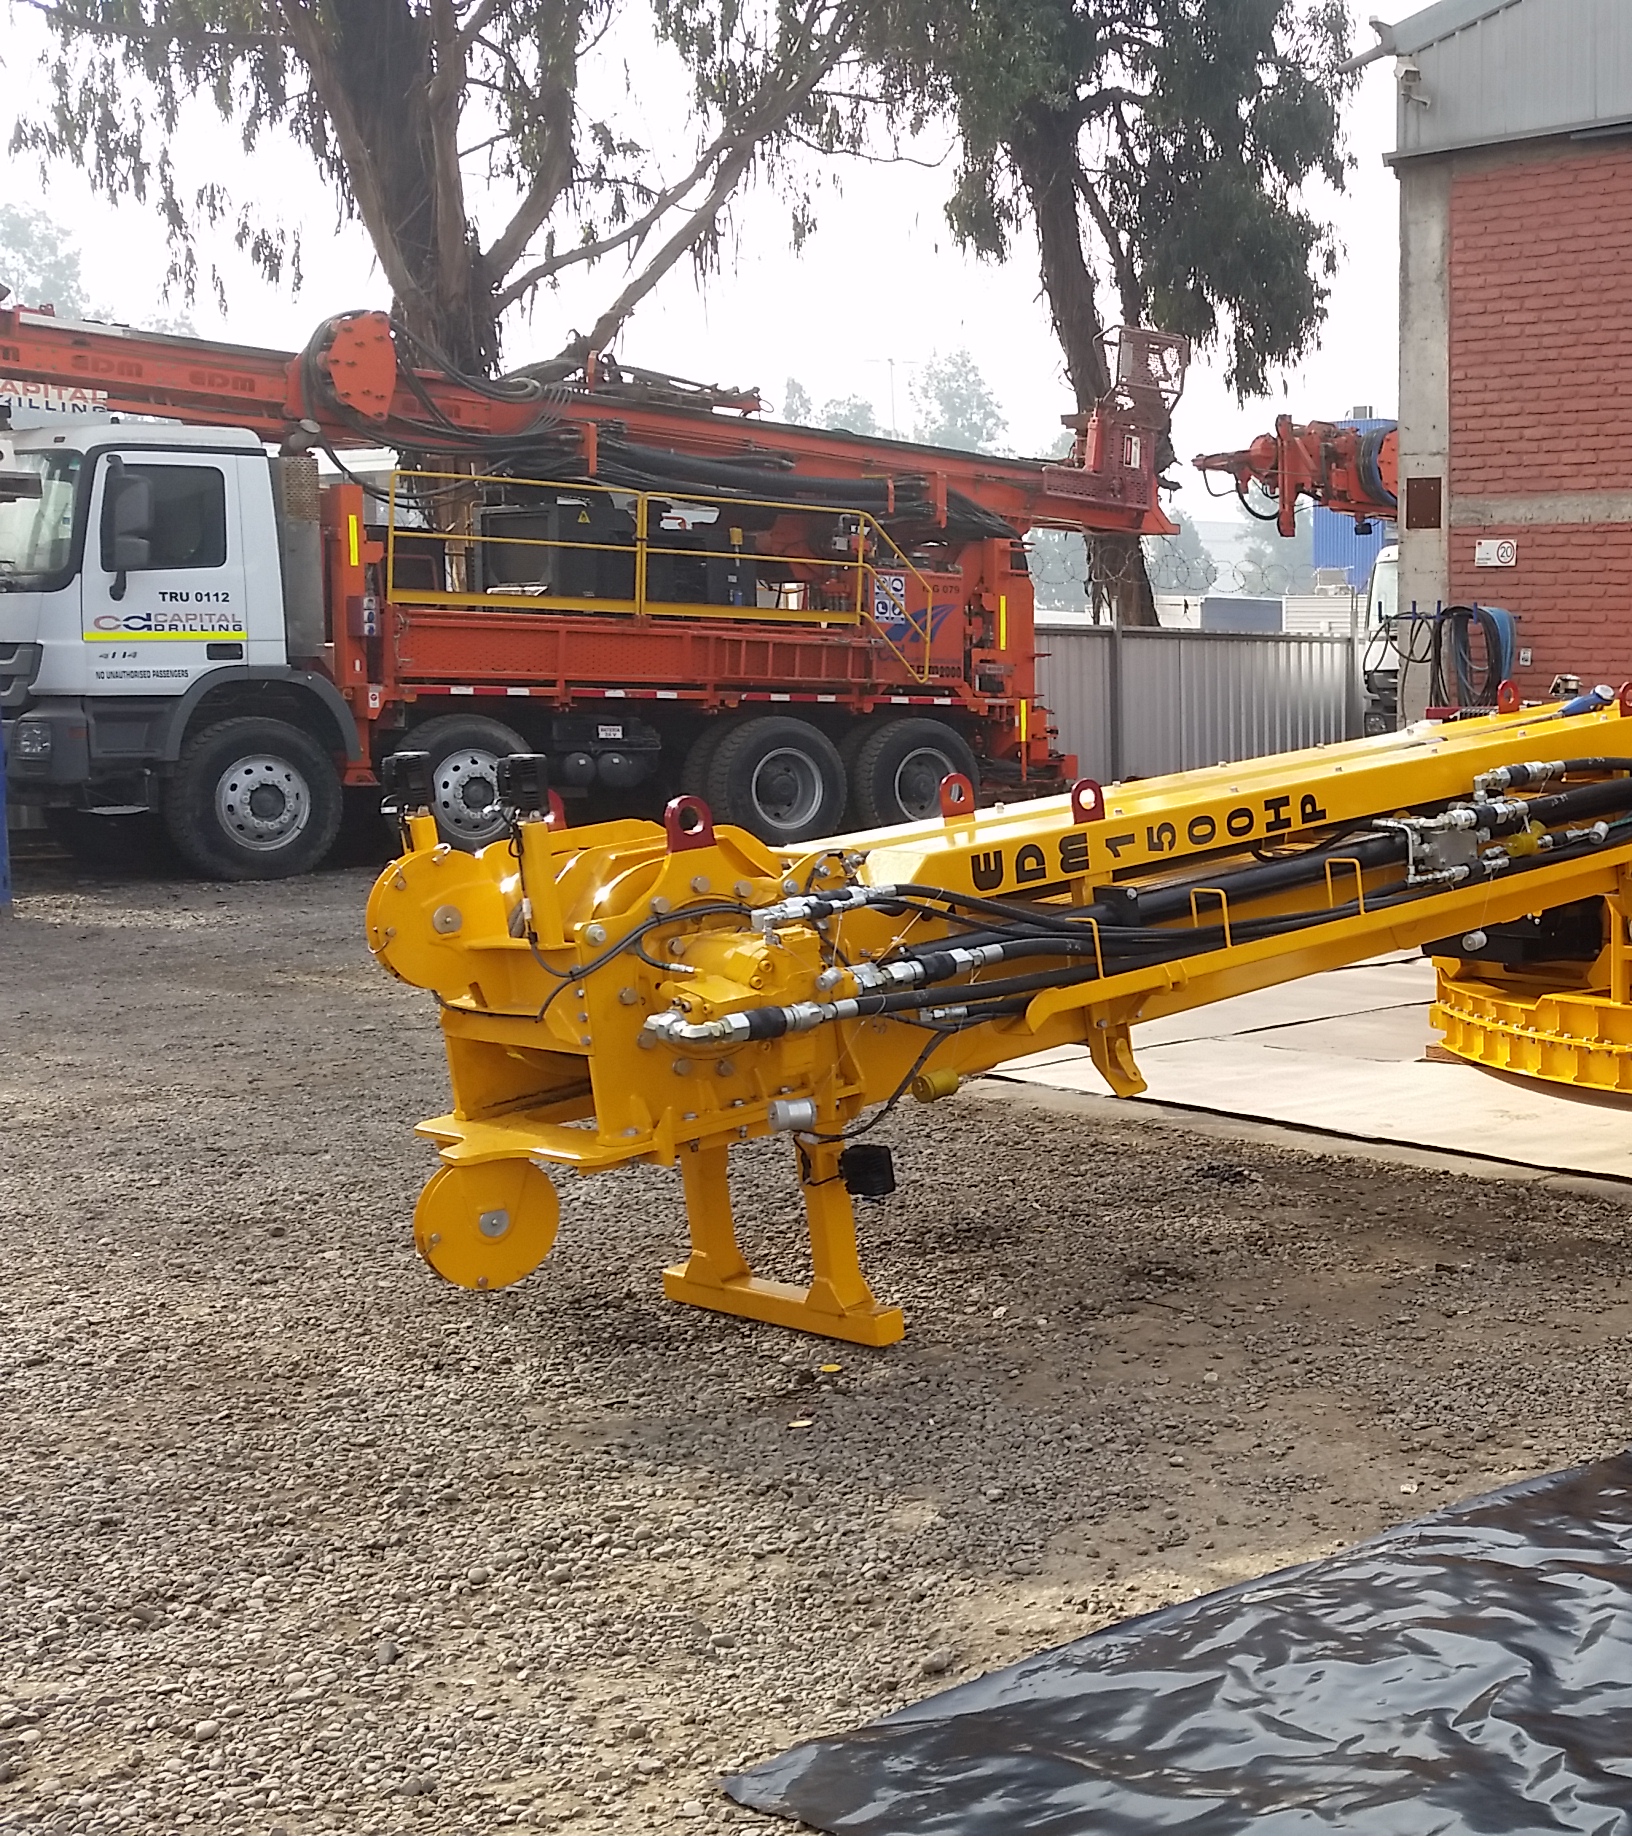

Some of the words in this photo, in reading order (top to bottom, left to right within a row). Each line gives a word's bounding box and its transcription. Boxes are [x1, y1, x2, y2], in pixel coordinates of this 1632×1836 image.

[1500, 545, 1513, 558] 20
[922, 584, 940, 593] RG
[942, 585, 960, 594] 079
[158, 591, 190, 602] TRU
[195, 592, 230, 603] 0112
[154, 613, 242, 623] CAPITAL
[154, 623, 243, 632] DRILLING
[96, 671, 105, 679] NO
[106, 670, 151, 679] UNAUTHORISED
[152, 669, 189, 678] PASSENGERS
